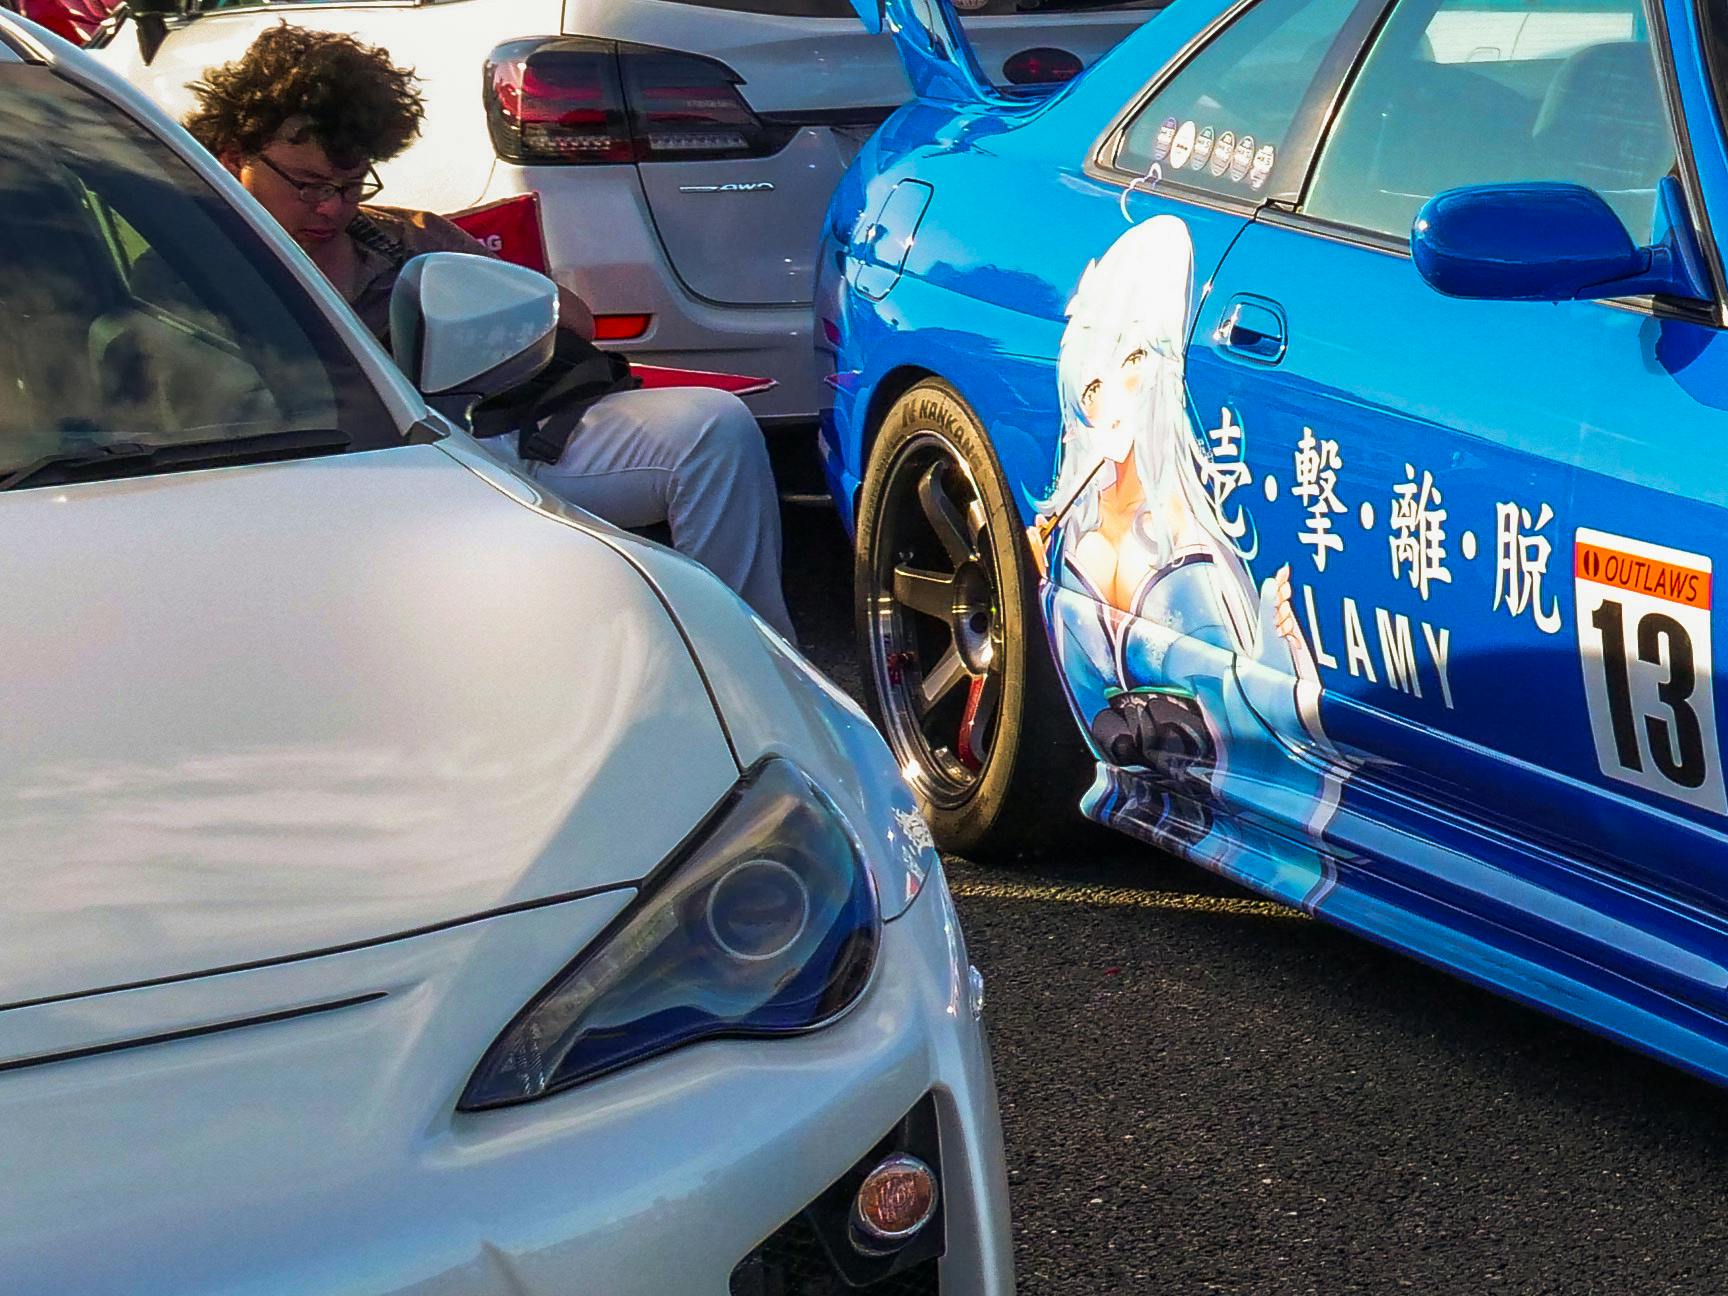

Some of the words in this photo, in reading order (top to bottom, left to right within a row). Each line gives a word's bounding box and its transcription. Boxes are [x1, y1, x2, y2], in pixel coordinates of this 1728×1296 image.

[1604, 554, 1700, 603] OUTLAWS
[1303, 584, 1454, 710] LAMY
[1591, 598, 1708, 790] 13
